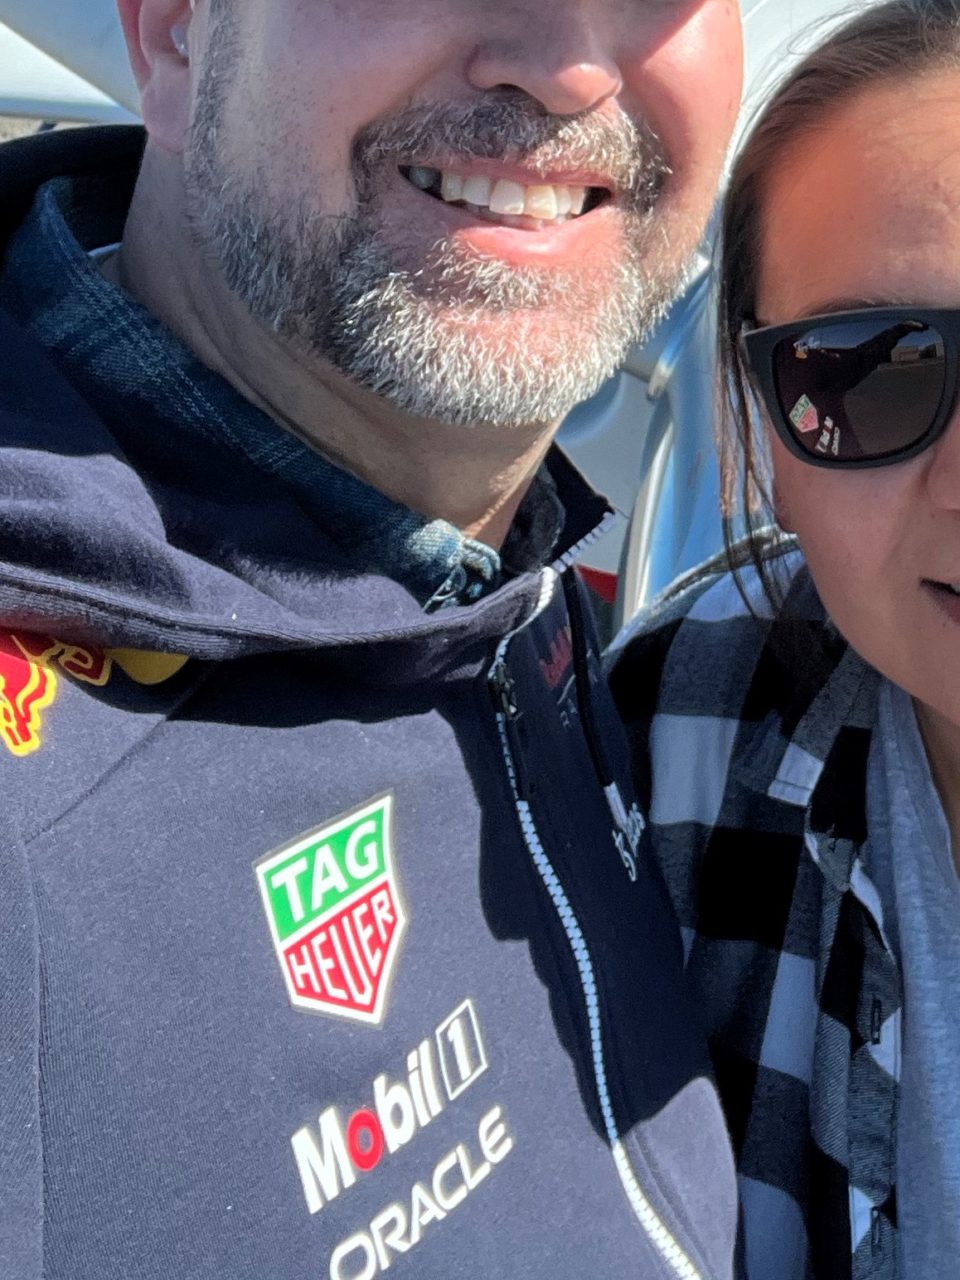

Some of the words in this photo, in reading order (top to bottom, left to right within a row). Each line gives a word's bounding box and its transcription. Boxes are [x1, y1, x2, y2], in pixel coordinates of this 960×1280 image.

[270, 819, 379, 923] TAG
[288, 888, 395, 1006] HEUER
[290, 1039, 443, 1215] Mobil
[329, 1105, 514, 1280] ORACLE
